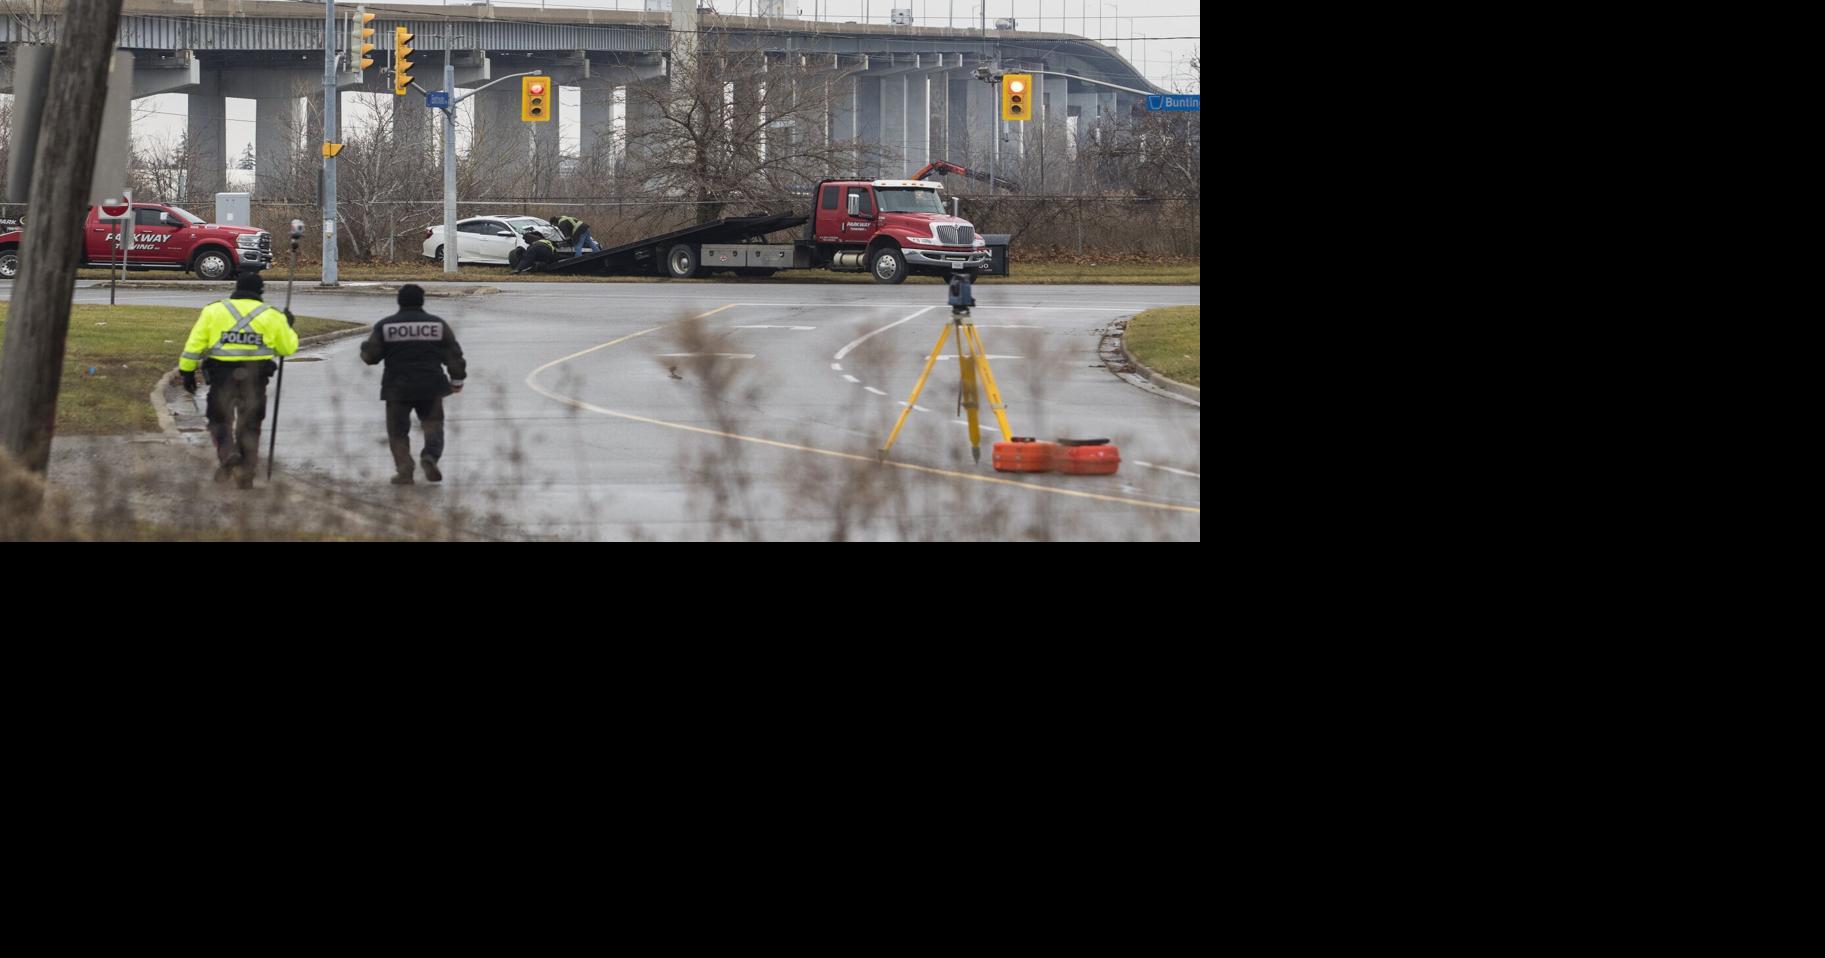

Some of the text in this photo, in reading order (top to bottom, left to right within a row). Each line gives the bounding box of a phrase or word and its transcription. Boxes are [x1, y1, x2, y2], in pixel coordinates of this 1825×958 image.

[1165, 96, 1200, 108] Buntin
[105, 233, 172, 243] PAKWAY
[388, 324, 439, 338] POLICE
[222, 332, 263, 345] POLICE
